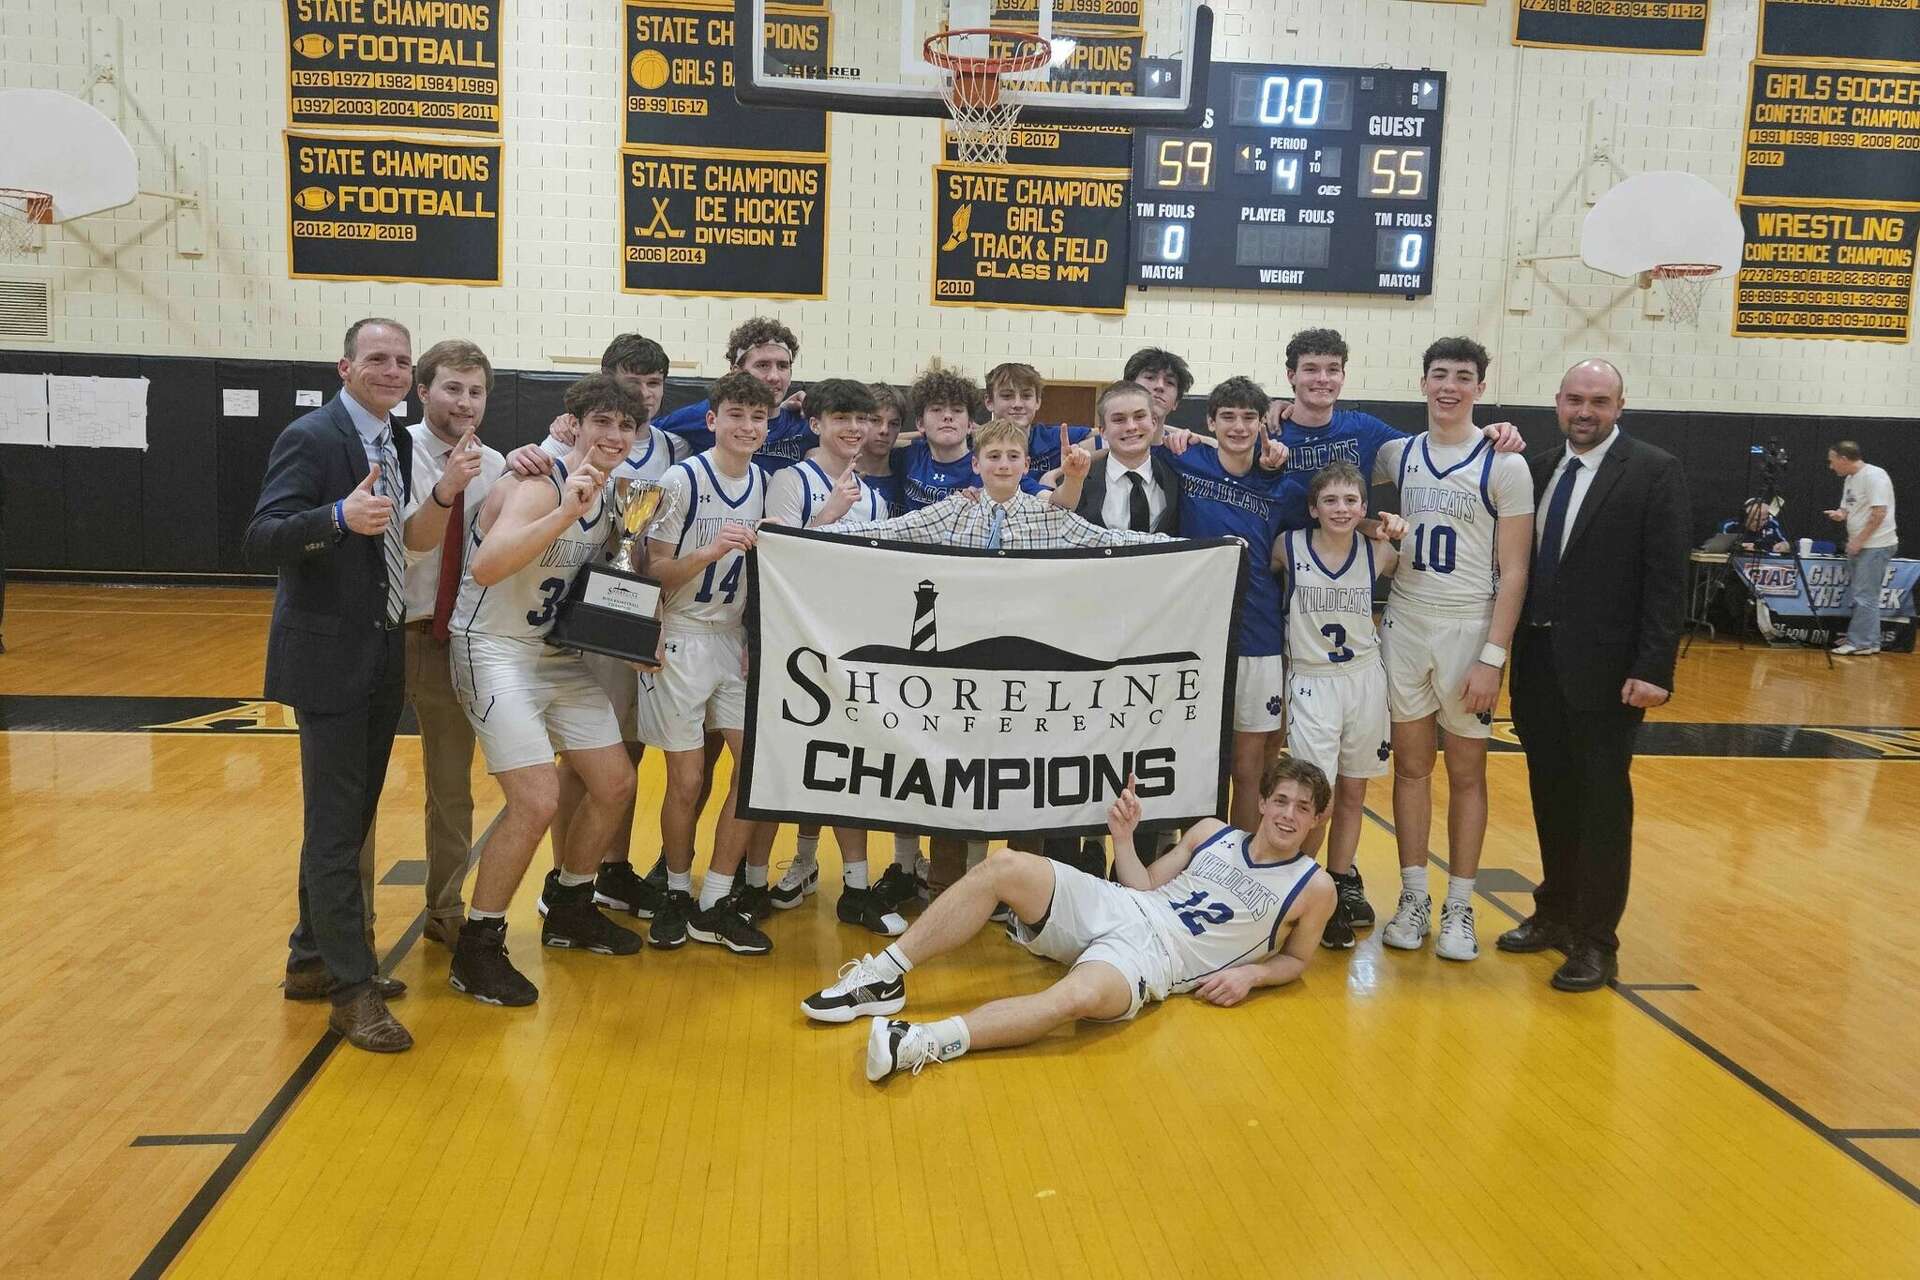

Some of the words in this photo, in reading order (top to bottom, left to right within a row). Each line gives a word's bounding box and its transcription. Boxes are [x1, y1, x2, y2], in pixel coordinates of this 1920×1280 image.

[298, 0, 365, 24] STATE
[373, 0, 489, 31] CHAMPIONS
[1070, 0, 1100, 12] 1999
[1105, 1, 1138, 13] 2000
[1632, 3, 1667, 17] 94-95
[1672, 4, 1703, 18] 11-12
[636, 15, 699, 45] STATE
[707, 19, 820, 51] CHPIONS
[337, 34, 496, 68] FOOTBALL
[294, 71, 330, 86] 1976
[336, 72, 371, 87] 1977
[378, 75, 413, 89] 1982
[420, 77, 454, 91] 1984
[461, 79, 494, 94] 1989
[672, 58, 716, 87] GIRLS
[1412, 82, 1419, 93] B
[1766, 74, 1832, 100] GIRLS
[1836, 76, 1920, 105] SOCCER
[296, 98, 330, 113] 1997
[336, 100, 373, 114] 2003
[379, 101, 415, 116] 2004
[421, 103, 455, 118] 2005
[462, 105, 493, 120] 2011
[630, 98, 667, 113] 98-99
[671, 99, 704, 114] 16-17
[1411, 95, 1418, 105] B
[1369, 115, 1425, 137] GUEST
[1756, 104, 1848, 125] CONFERENCE
[1852, 108, 1920, 129] CHAMPION
[1024, 133, 1057, 147] 2017
[1270, 137, 1308, 151] PERIOD
[1754, 130, 1781, 143] 1991
[1790, 132, 1819, 144] 1998
[1827, 133, 1855, 146] 1999
[1861, 134, 1892, 147] 2008
[1897, 136, 1920, 149] 200
[299, 147, 366, 176] STATE
[372, 150, 489, 182] CHAMPIONS
[1158, 140, 1213, 187] 59
[1255, 148, 1262, 159] P
[1314, 150, 1322, 161] P
[1749, 152, 1781, 165] 2017
[1255, 160, 1267, 171] TO
[1276, 157, 1299, 190] 4
[1309, 162, 1321, 173] TO
[1370, 149, 1425, 196] 55
[631, 161, 697, 190] STATE
[705, 166, 818, 195] CHAMPIONS
[338, 186, 496, 218] FOOTBALL
[950, 175, 1010, 203] STATE
[1016, 179, 1124, 208] CHAMPIONS
[695, 196, 727, 223] ICE
[735, 198, 815, 225] HOCKEY
[1007, 206, 1064, 234] GIRLS
[1136, 203, 1154, 217] TM
[1158, 204, 1195, 219] FOULS
[1241, 207, 1286, 222] PLAYER
[1298, 209, 1335, 224] FOULS
[1375, 212, 1392, 227] TM
[1396, 213, 1432, 228] FOULS
[296, 222, 332, 237] 2012
[337, 224, 372, 238] 2017
[378, 225, 414, 240] 2018
[695, 227, 775, 246] DIVISION
[781, 230, 798, 248] II
[1757, 213, 1904, 242] WRESTLING
[971, 232, 1033, 260] TRACK
[1036, 240, 1050, 261] &
[1054, 236, 1108, 264] FIELD
[1163, 224, 1185, 260] 0
[1400, 233, 1423, 268] 0
[629, 247, 662, 261] 2006
[669, 249, 703, 263] 2014
[1744, 243, 1832, 263] CONFERENCE
[1837, 245, 1912, 267] CHAMPIONS
[976, 260, 1050, 280] CLASS
[1057, 265, 1090, 283] MM
[1141, 265, 1184, 280] MATCH
[1260, 269, 1304, 285] WEIGHT
[1379, 273, 1421, 288] MATCH
[1741, 269, 1773, 281] 77-78
[1775, 270, 1807, 282] 79-80
[1810, 271, 1841, 283] 81-82
[940, 281, 971, 294] 2010
[1739, 312, 1772, 324] 05-06
[1775, 313, 1807, 325] 07-08
[1284, 438, 1361, 474] ILDCATS
[1405, 486, 1477, 524] WILDCATS
[1412, 523, 1456, 574] 10
[695, 556, 744, 604] 14
[1809, 565, 1850, 586] GAM
[1296, 585, 1370, 617] WILDCATS
[1808, 587, 1845, 608] THE
[1321, 624, 1355, 663] 3
[782, 647, 1200, 727] SHORELINE
[845, 705, 1197, 733] CONFERENCE
[803, 739, 1177, 810] CHAMPIONS
[1193, 852, 1279, 921] WILDCATS
[1168, 890, 1235, 936] 12
